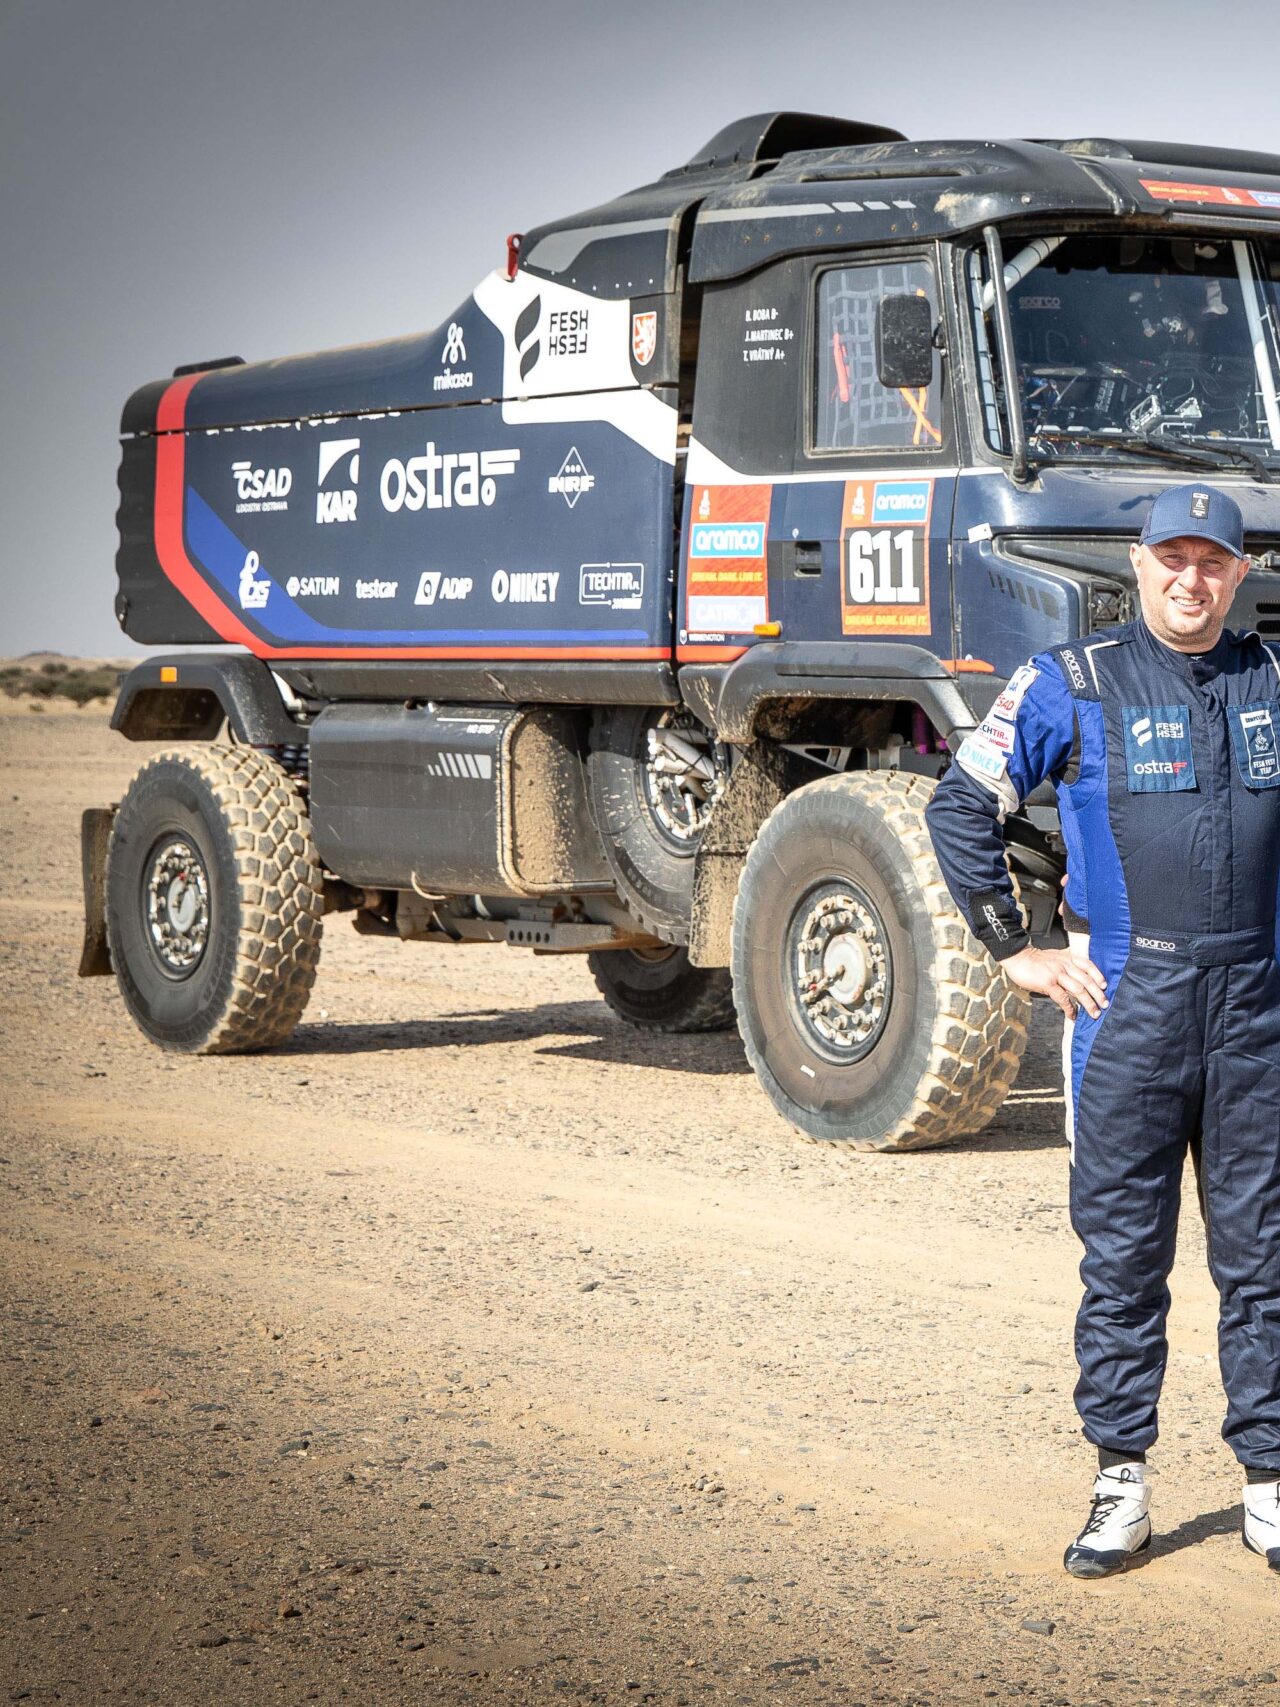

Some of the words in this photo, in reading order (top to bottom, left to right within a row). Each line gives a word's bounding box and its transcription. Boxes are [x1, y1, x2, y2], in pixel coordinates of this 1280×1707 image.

[550, 310, 589, 333] FESH
[433, 367, 474, 391] mikasa
[548, 475, 595, 493] NRF
[316, 490, 358, 524] KAR
[876, 494, 926, 511] aramco
[695, 529, 759, 551] aramco
[849, 530, 920, 603] 611
[300, 577, 340, 596] SATUM
[355, 578, 398, 599] testcar
[439, 577, 473, 600] ADIP
[1063, 650, 1086, 688] sparco
[1155, 722, 1183, 730] FESH
[983, 905, 1009, 942] sparco
[1136, 936, 1176, 951] sparco
